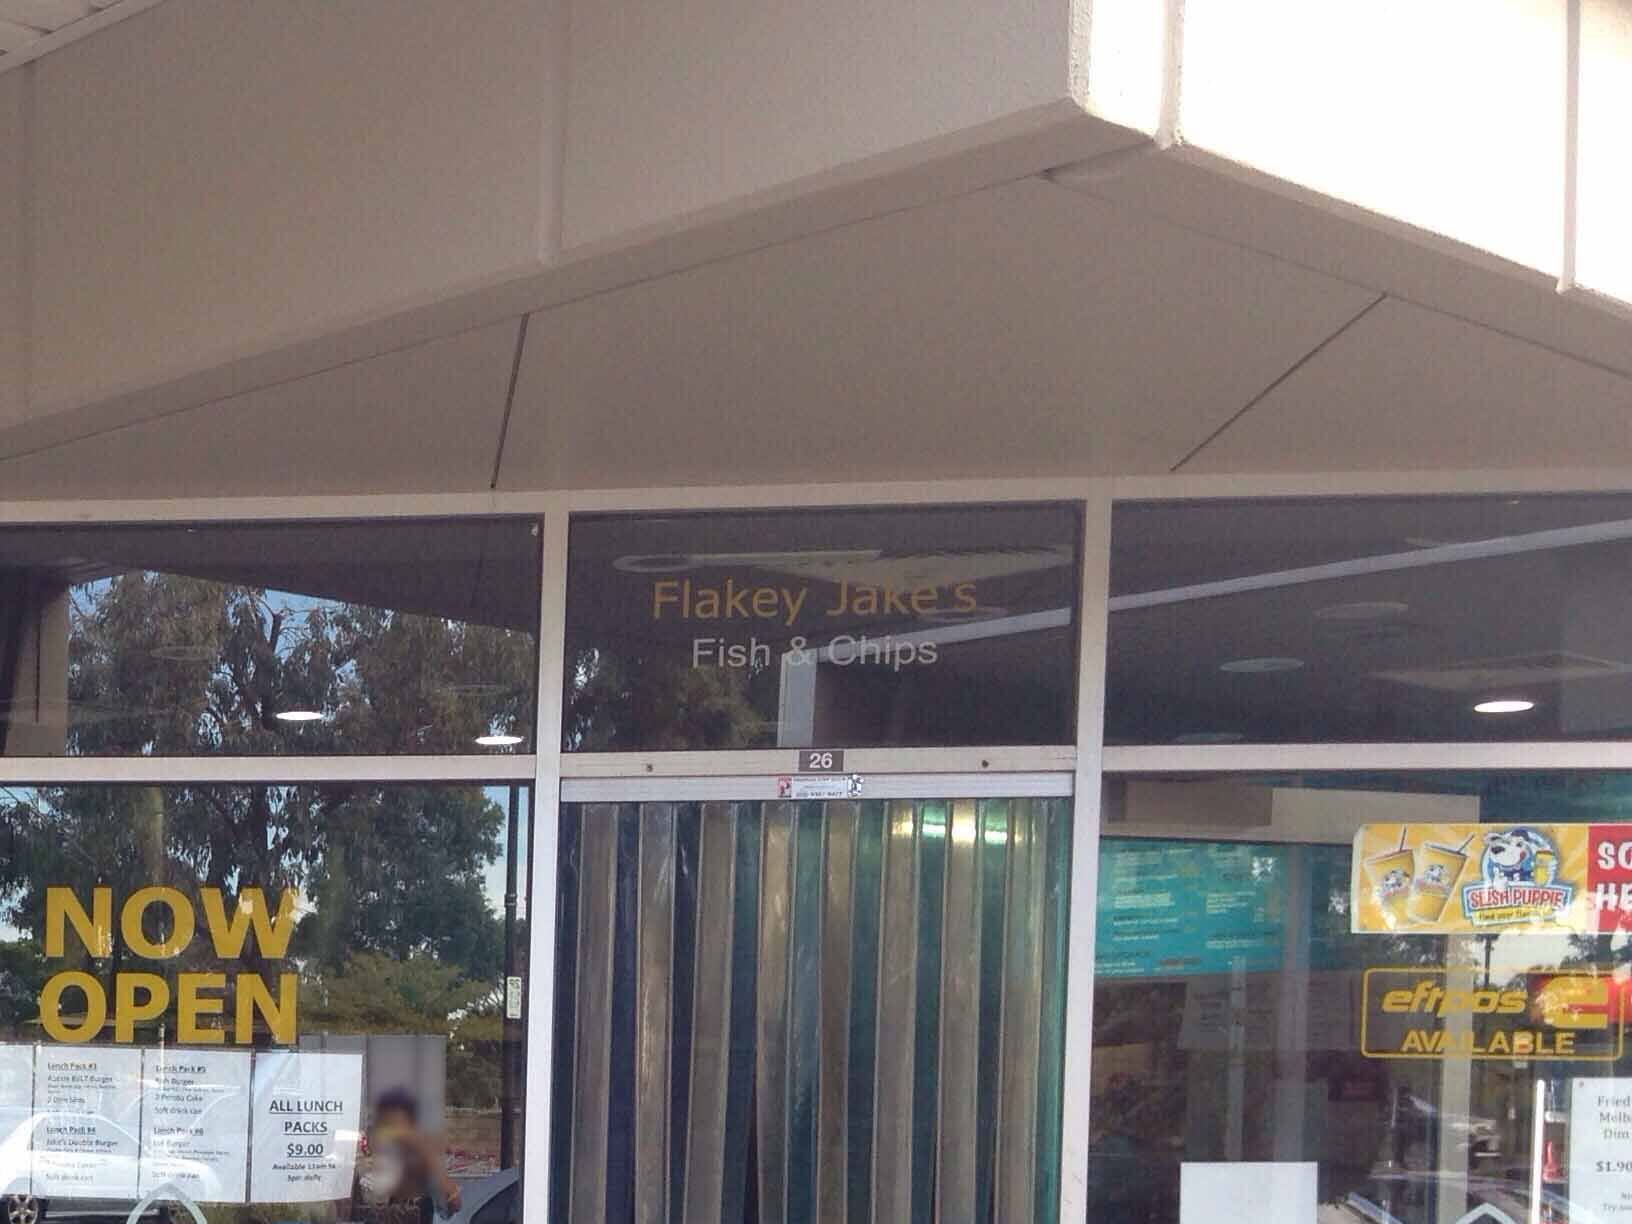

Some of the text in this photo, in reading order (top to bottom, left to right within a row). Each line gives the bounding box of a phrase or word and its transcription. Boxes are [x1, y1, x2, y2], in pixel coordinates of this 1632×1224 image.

[652, 577, 977, 625] Flakey Jake's
[692, 634, 938, 672] Fish & Chips
[809, 752, 833, 769] 26
[1513, 886, 1564, 909] PUPPIE
[45, 886, 296, 959] NOW
[40, 971, 299, 1044] OPEN
[1382, 980, 1528, 1017] eftpos
[1401, 1031, 1576, 1055] AVAILABLE
[269, 1099, 344, 1113] ALL LUNCH
[1597, 1095, 1631, 1107] Fried
[284, 1121, 328, 1133] PACKS
[1603, 1129, 1630, 1139] Dim
[288, 1142, 324, 1156] $9.00
